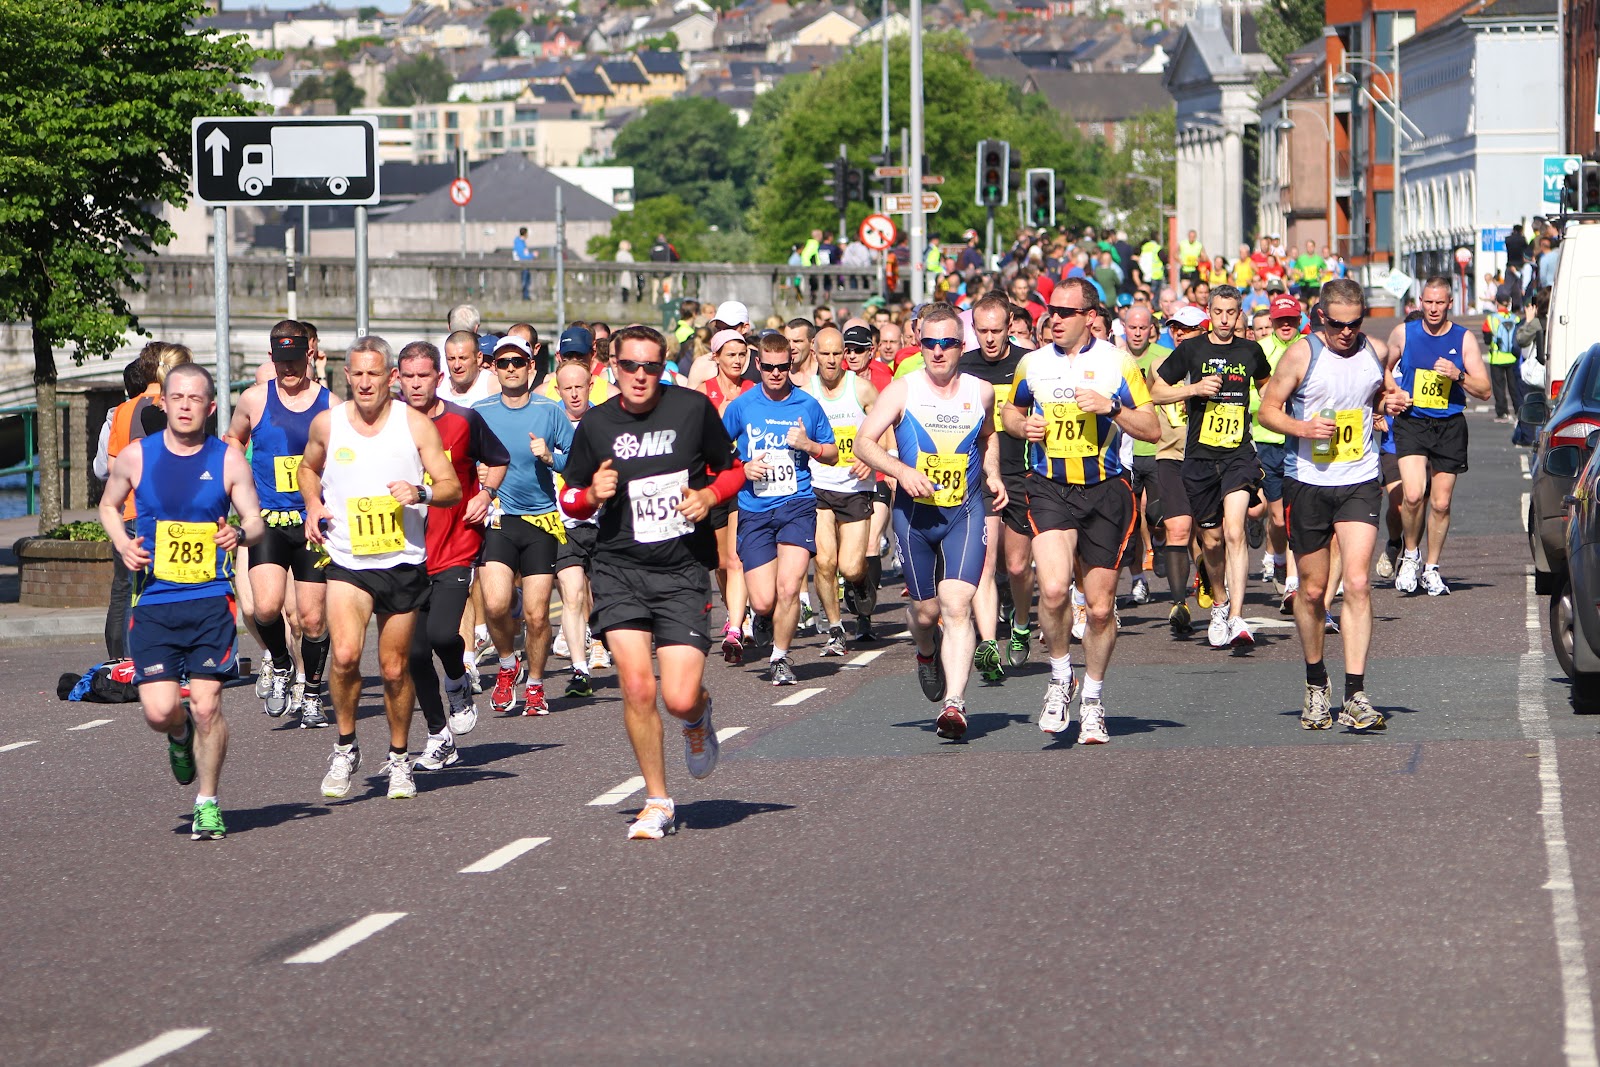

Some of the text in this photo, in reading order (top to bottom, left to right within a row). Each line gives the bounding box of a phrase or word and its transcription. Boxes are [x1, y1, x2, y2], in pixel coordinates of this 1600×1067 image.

[1544, 174, 1565, 190] YE
[1053, 388, 1075, 399] CO
[1421, 382, 1444, 397] 685
[828, 412, 846, 421] OGHER
[936, 413, 960, 424] COS
[1208, 415, 1240, 435] 1313
[1055, 420, 1086, 441] 787
[637, 429, 677, 458] NR
[757, 465, 794, 482] 4139
[636, 493, 687, 522] A459
[355, 512, 396, 536] 1111
[168, 540, 204, 564] 283
